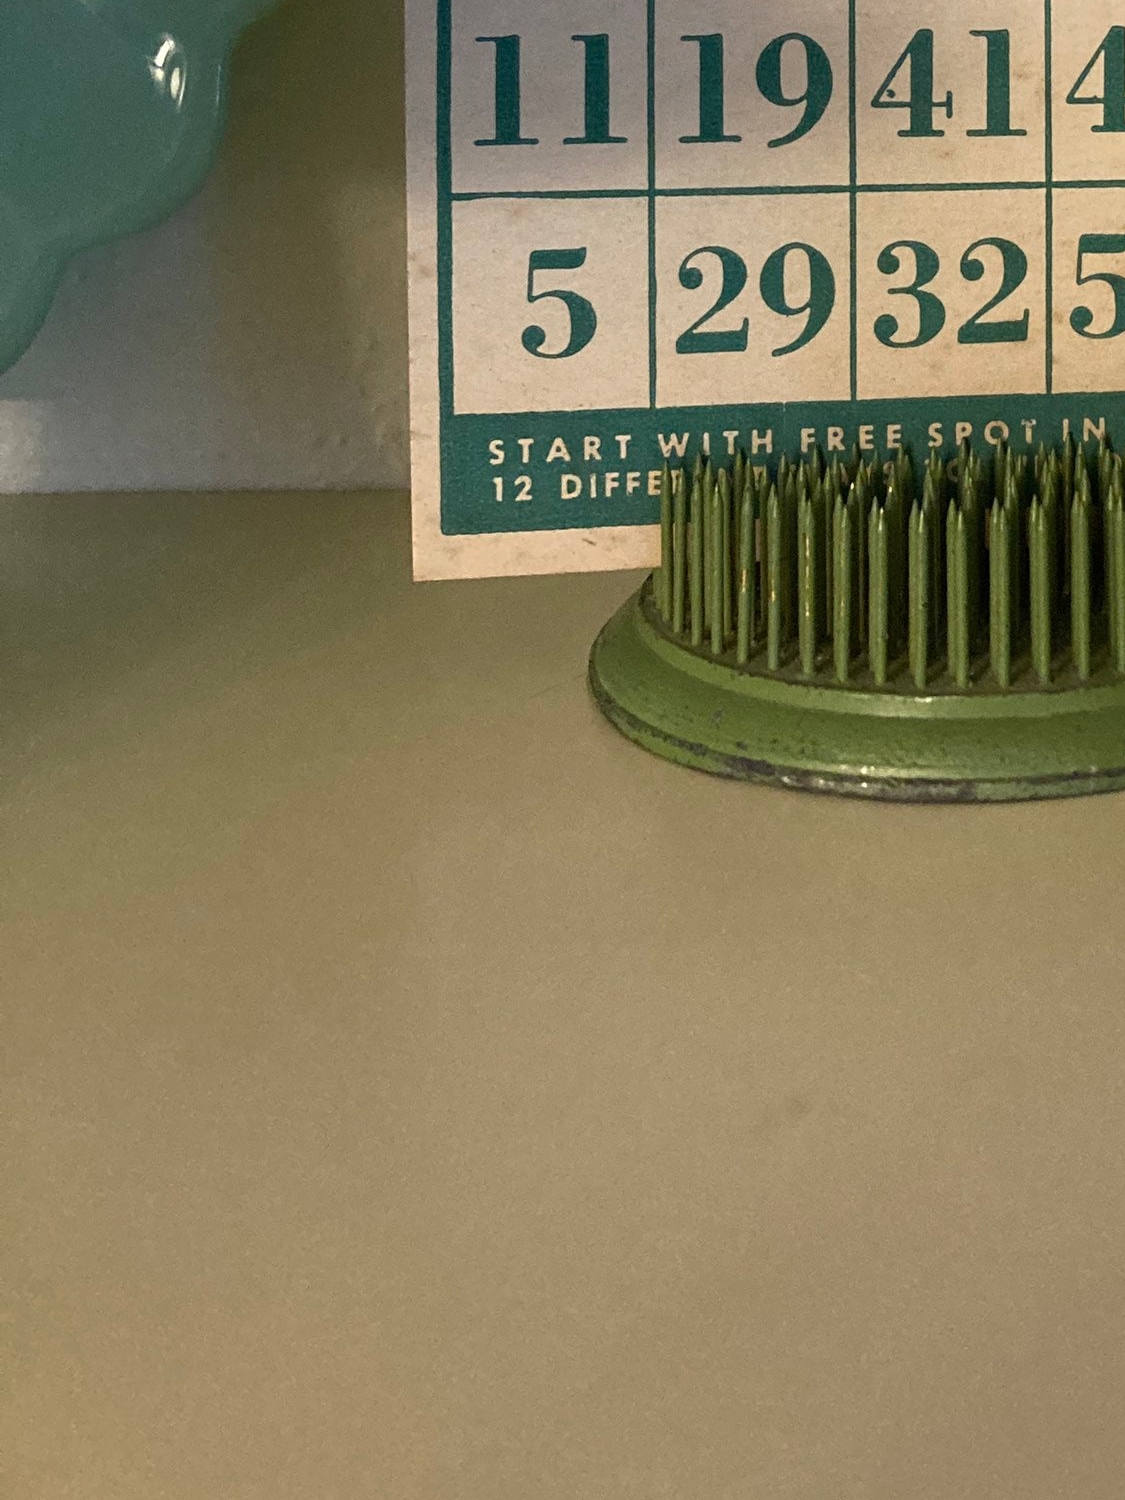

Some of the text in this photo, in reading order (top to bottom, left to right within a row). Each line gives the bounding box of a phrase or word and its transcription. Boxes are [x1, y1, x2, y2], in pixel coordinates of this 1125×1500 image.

[474, 32, 629, 147] 11
[680, 32, 834, 148] 19
[871, 28, 1025, 138] 41
[521, 246, 597, 358] 5
[675, 243, 836, 357] 29
[873, 237, 1029, 348] 32
[489, 432, 633, 465] START
[656, 429, 774, 458] WITH
[800, 424, 902, 453] FREE
[927, 418, 1038, 448] SPOT
[1062, 416, 1106, 443] IN
[492, 475, 532, 502] 12
